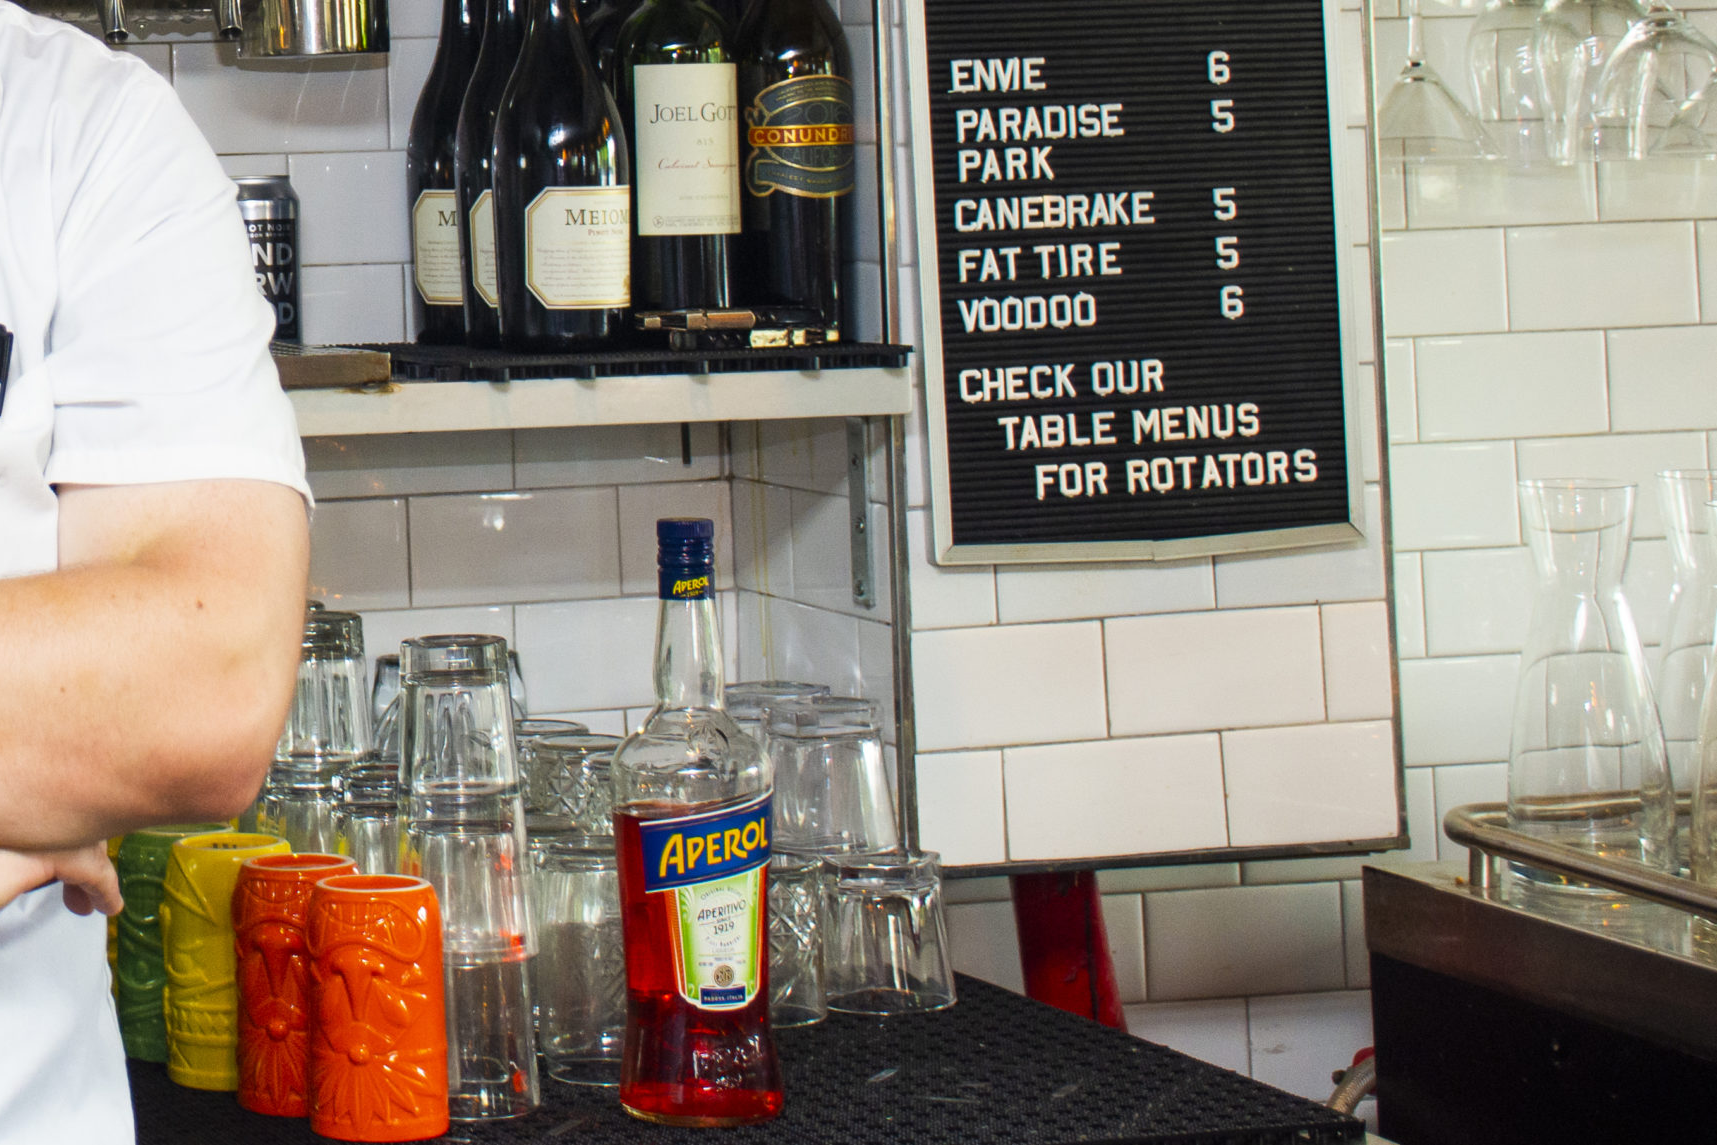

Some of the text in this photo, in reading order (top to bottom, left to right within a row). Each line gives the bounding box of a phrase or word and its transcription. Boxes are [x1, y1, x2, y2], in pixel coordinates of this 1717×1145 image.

[949, 50, 1231, 93] ENVIE 6
[650, 103, 698, 124] JOEL
[956, 99, 1235, 143] PARADISE 5
[957, 146, 1054, 183] PARK
[954, 187, 1237, 232] CANEBRAKE 5
[251, 242, 293, 267] ND
[957, 236, 1240, 283] FAT TIRE 5
[957, 285, 1244, 333] VOODOO 6
[959, 358, 1165, 403] CHECK OUR
[998, 403, 1260, 450] TABLE MENUS
[1035, 448, 1318, 501] FOR ROTATORS
[672, 576, 709, 595] APEROL
[659, 817, 769, 878] APEROL
[697, 899, 746, 921] APERITIVO
[713, 920, 735, 935] 1919
